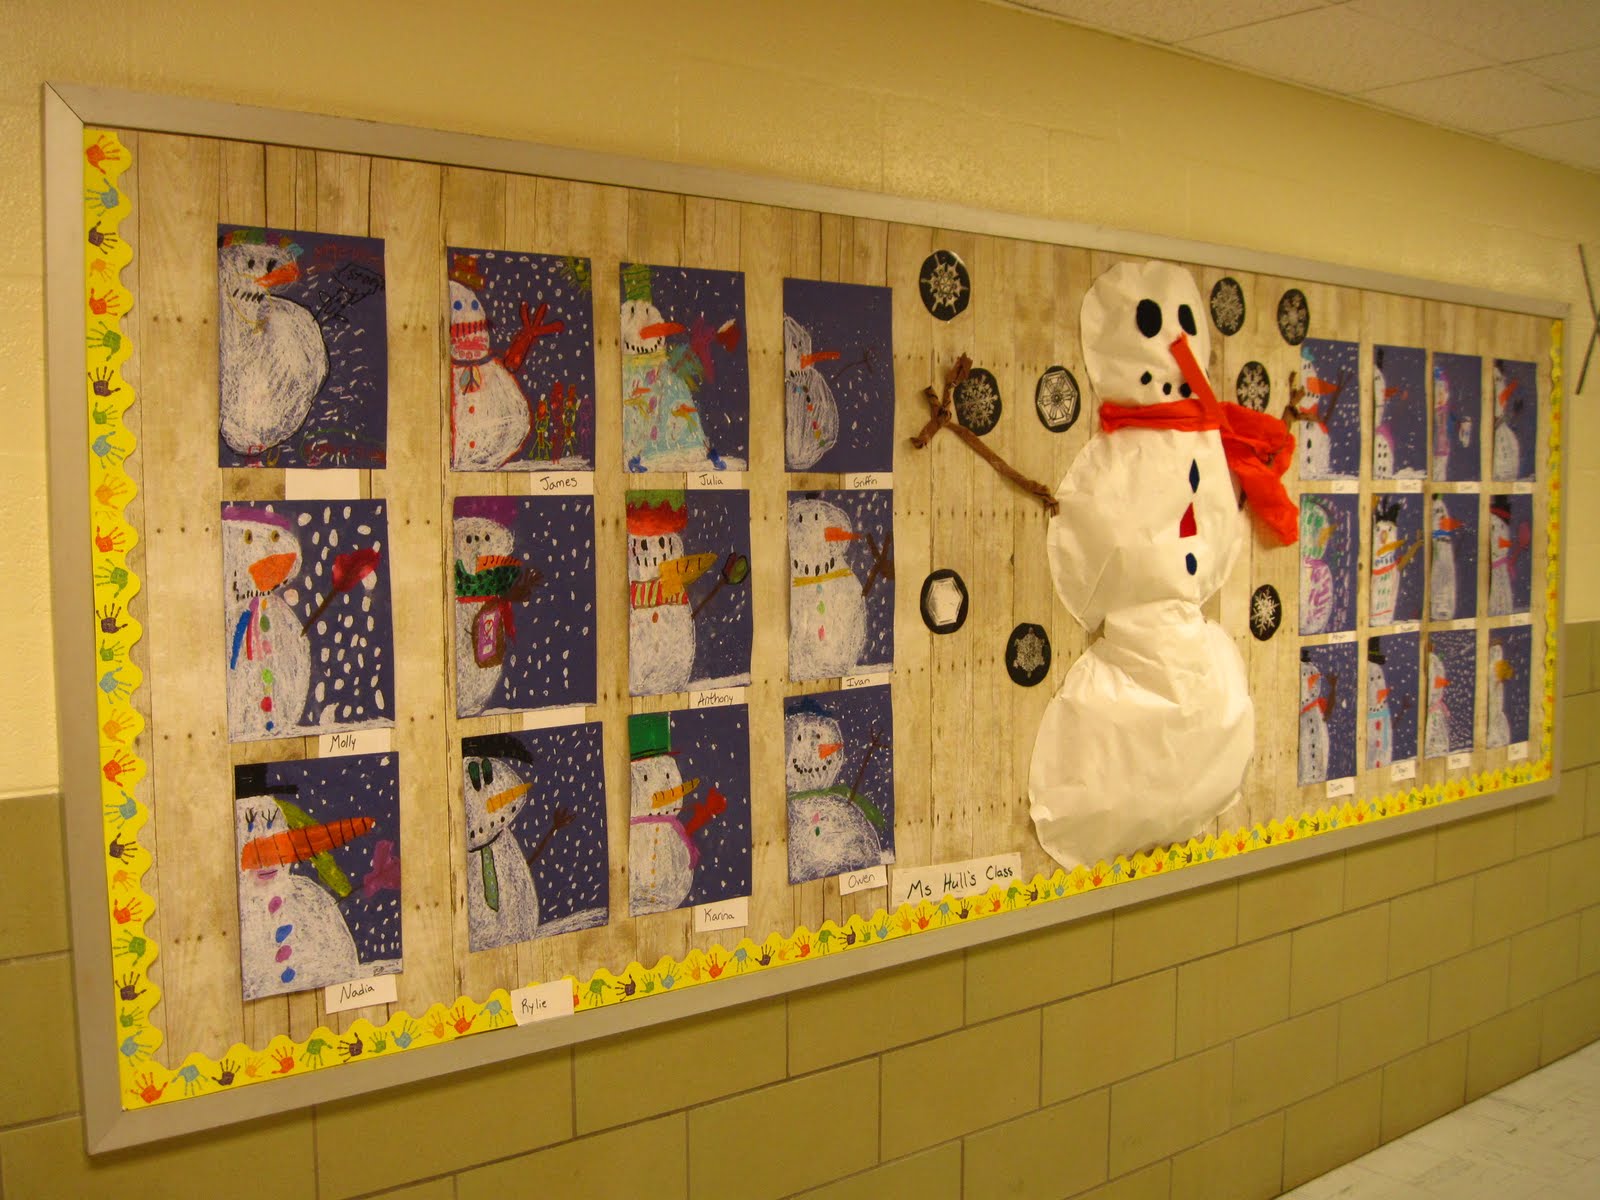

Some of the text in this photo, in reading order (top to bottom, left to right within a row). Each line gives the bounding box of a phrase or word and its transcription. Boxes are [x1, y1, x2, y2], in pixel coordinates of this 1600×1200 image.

[539, 476, 578, 490] James
[698, 475, 724, 486] Julia
[846, 677, 870, 687] Ivan
[697, 692, 733, 706] Anthony
[329, 734, 357, 752] Molly
[847, 872, 876, 889] Owen
[907, 865, 1014, 900] Ms Hull's Class
[339, 983, 376, 1003] Nadia
[520, 998, 547, 1016] Rylie
